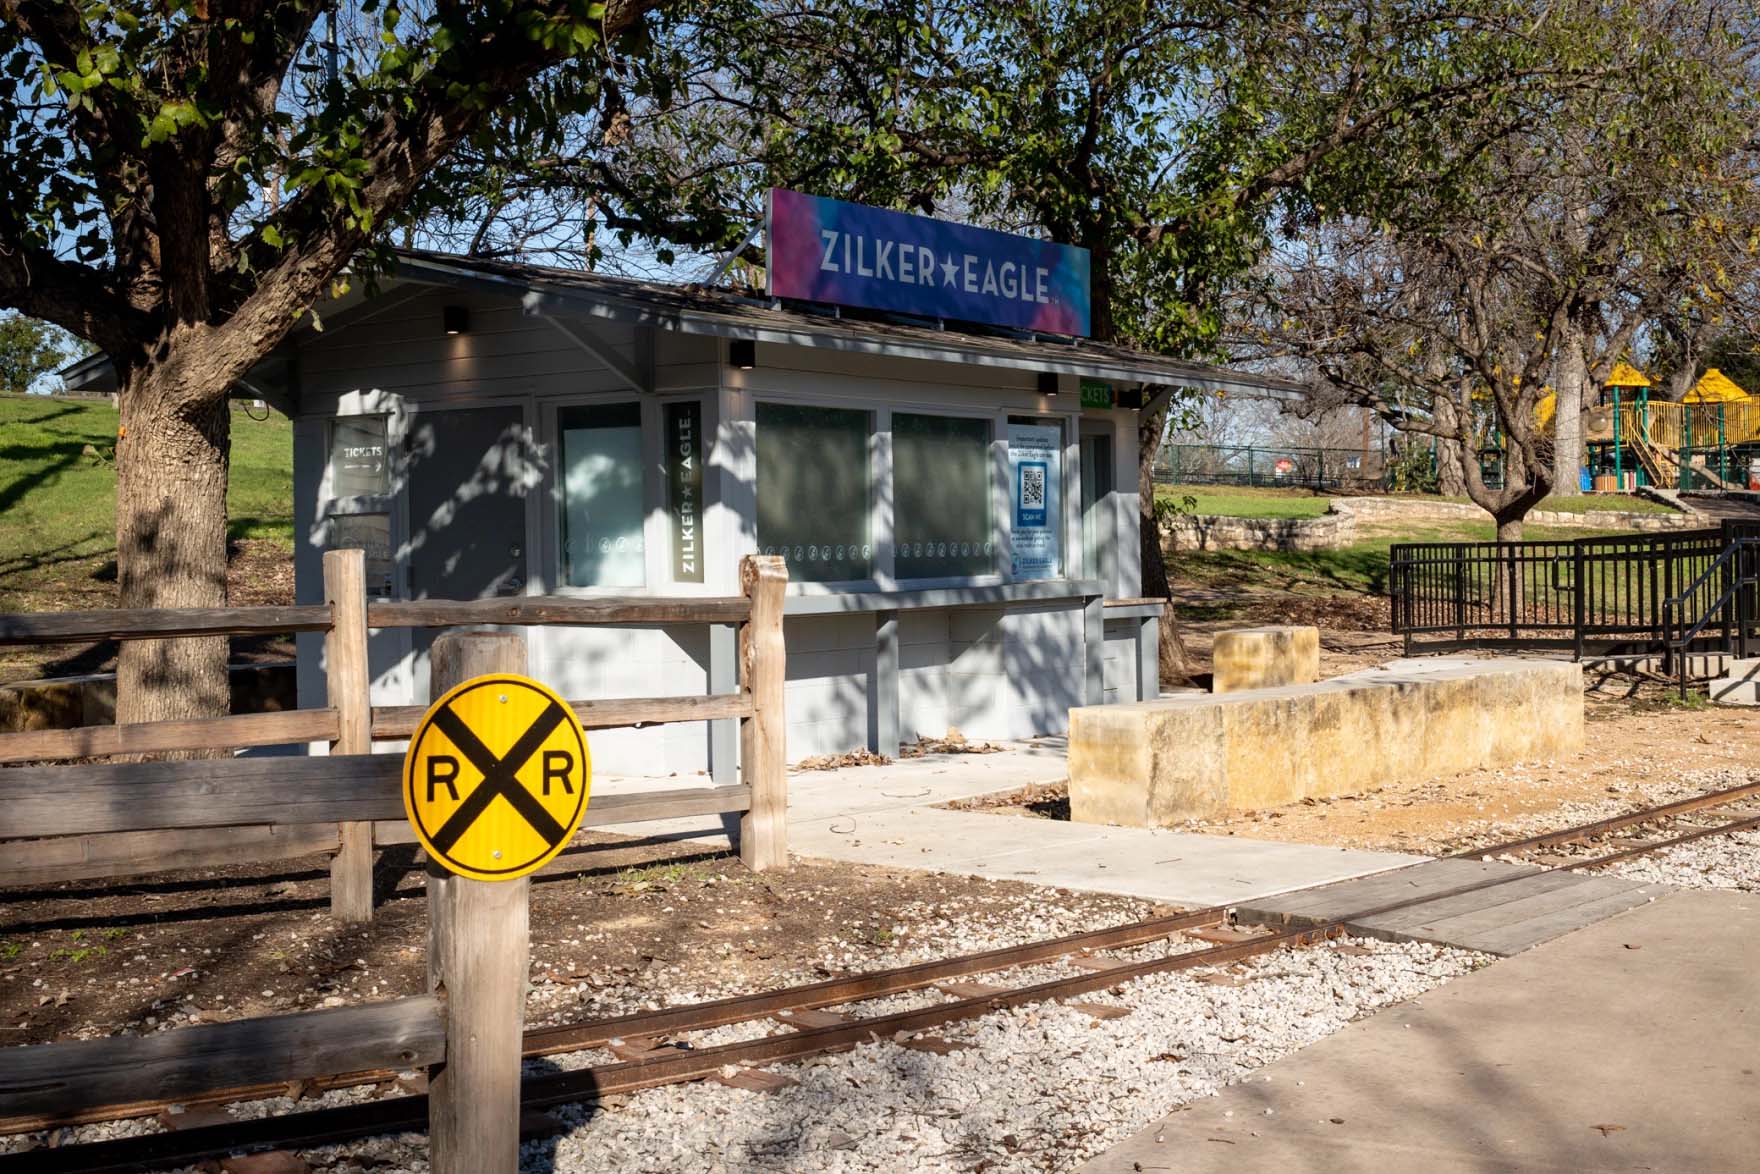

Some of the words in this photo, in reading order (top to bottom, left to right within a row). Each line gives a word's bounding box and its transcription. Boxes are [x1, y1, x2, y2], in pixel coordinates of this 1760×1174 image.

[820, 229, 935, 287] ZILKER
[963, 254, 1049, 304] EAGLE
[1080, 385, 1109, 403] CKETS
[344, 446, 382, 458] TICKETS
[680, 417, 693, 482] EAGLE
[682, 502, 695, 573] ZILKER
[427, 755, 460, 802] R
[542, 750, 575, 795] R
